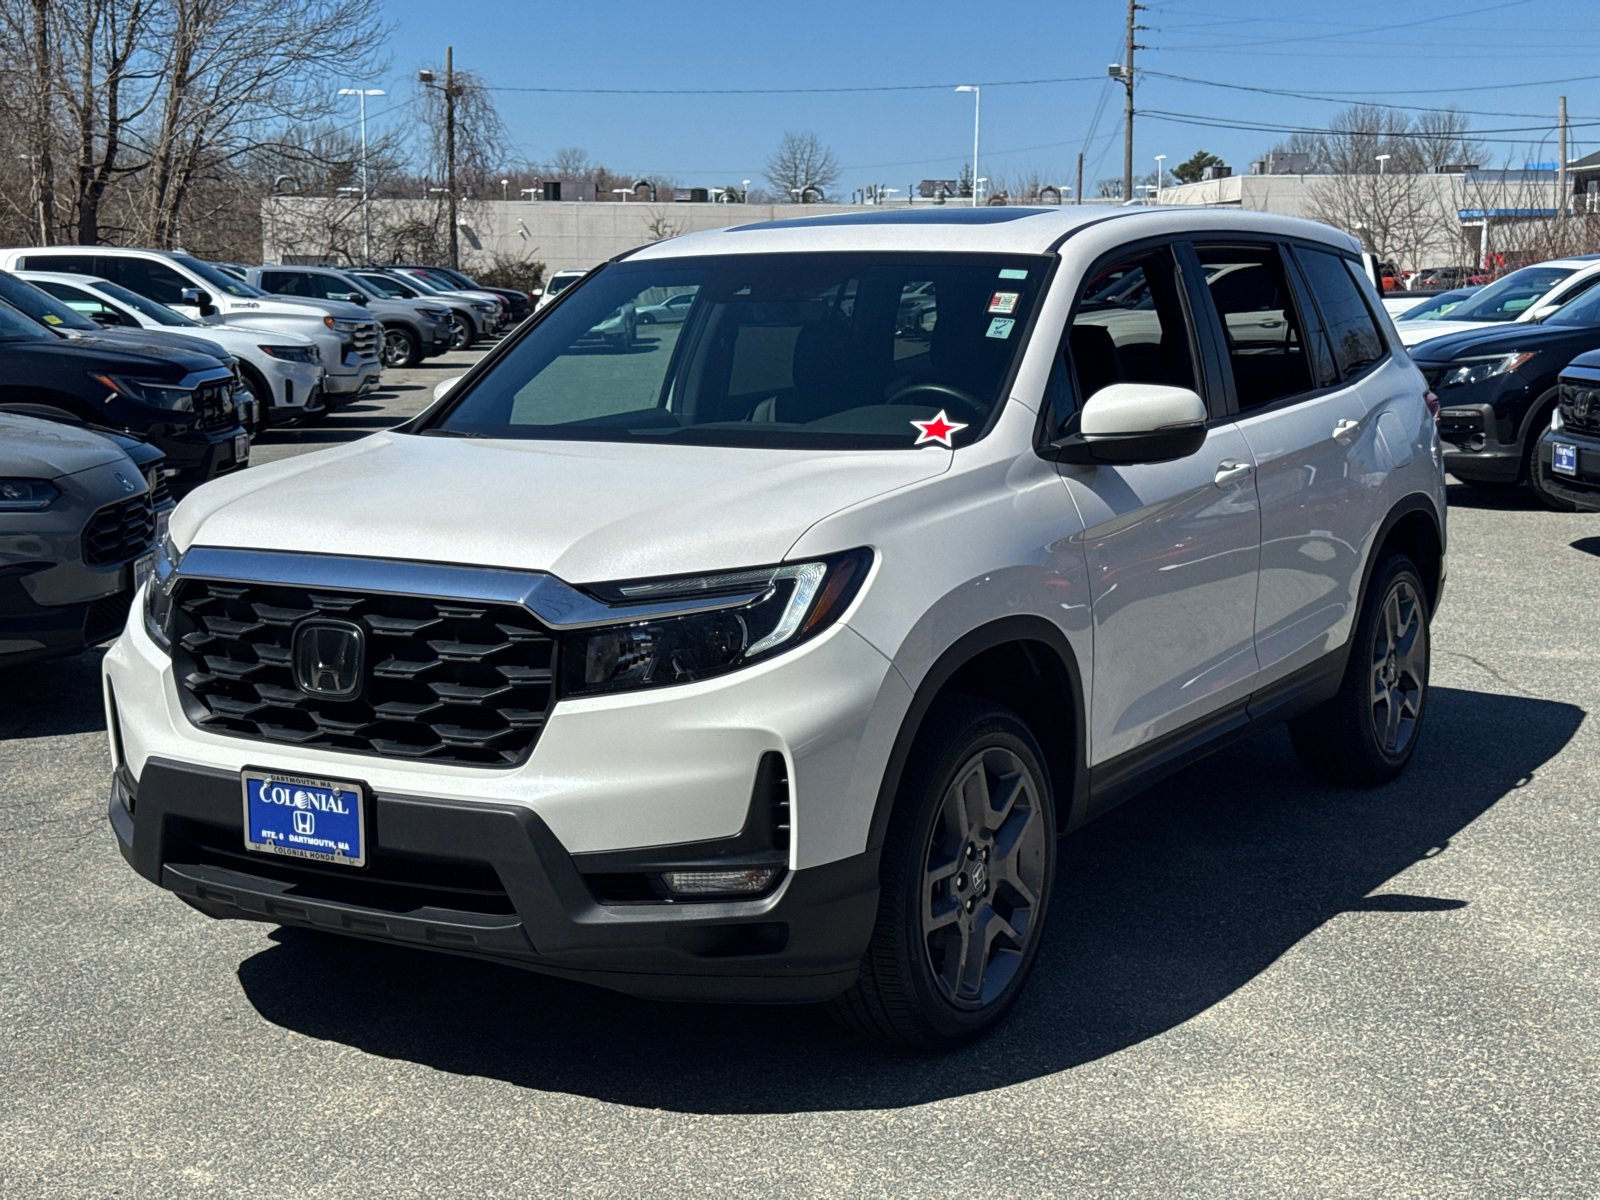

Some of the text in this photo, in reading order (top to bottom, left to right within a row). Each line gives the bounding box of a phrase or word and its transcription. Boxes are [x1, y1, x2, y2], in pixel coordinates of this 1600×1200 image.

[259, 785, 349, 814] COLONIAL
[262, 830, 350, 851] RTE. 6 DARTMOUTH, MA
[274, 846, 335, 862] COLONIAL HONDA
